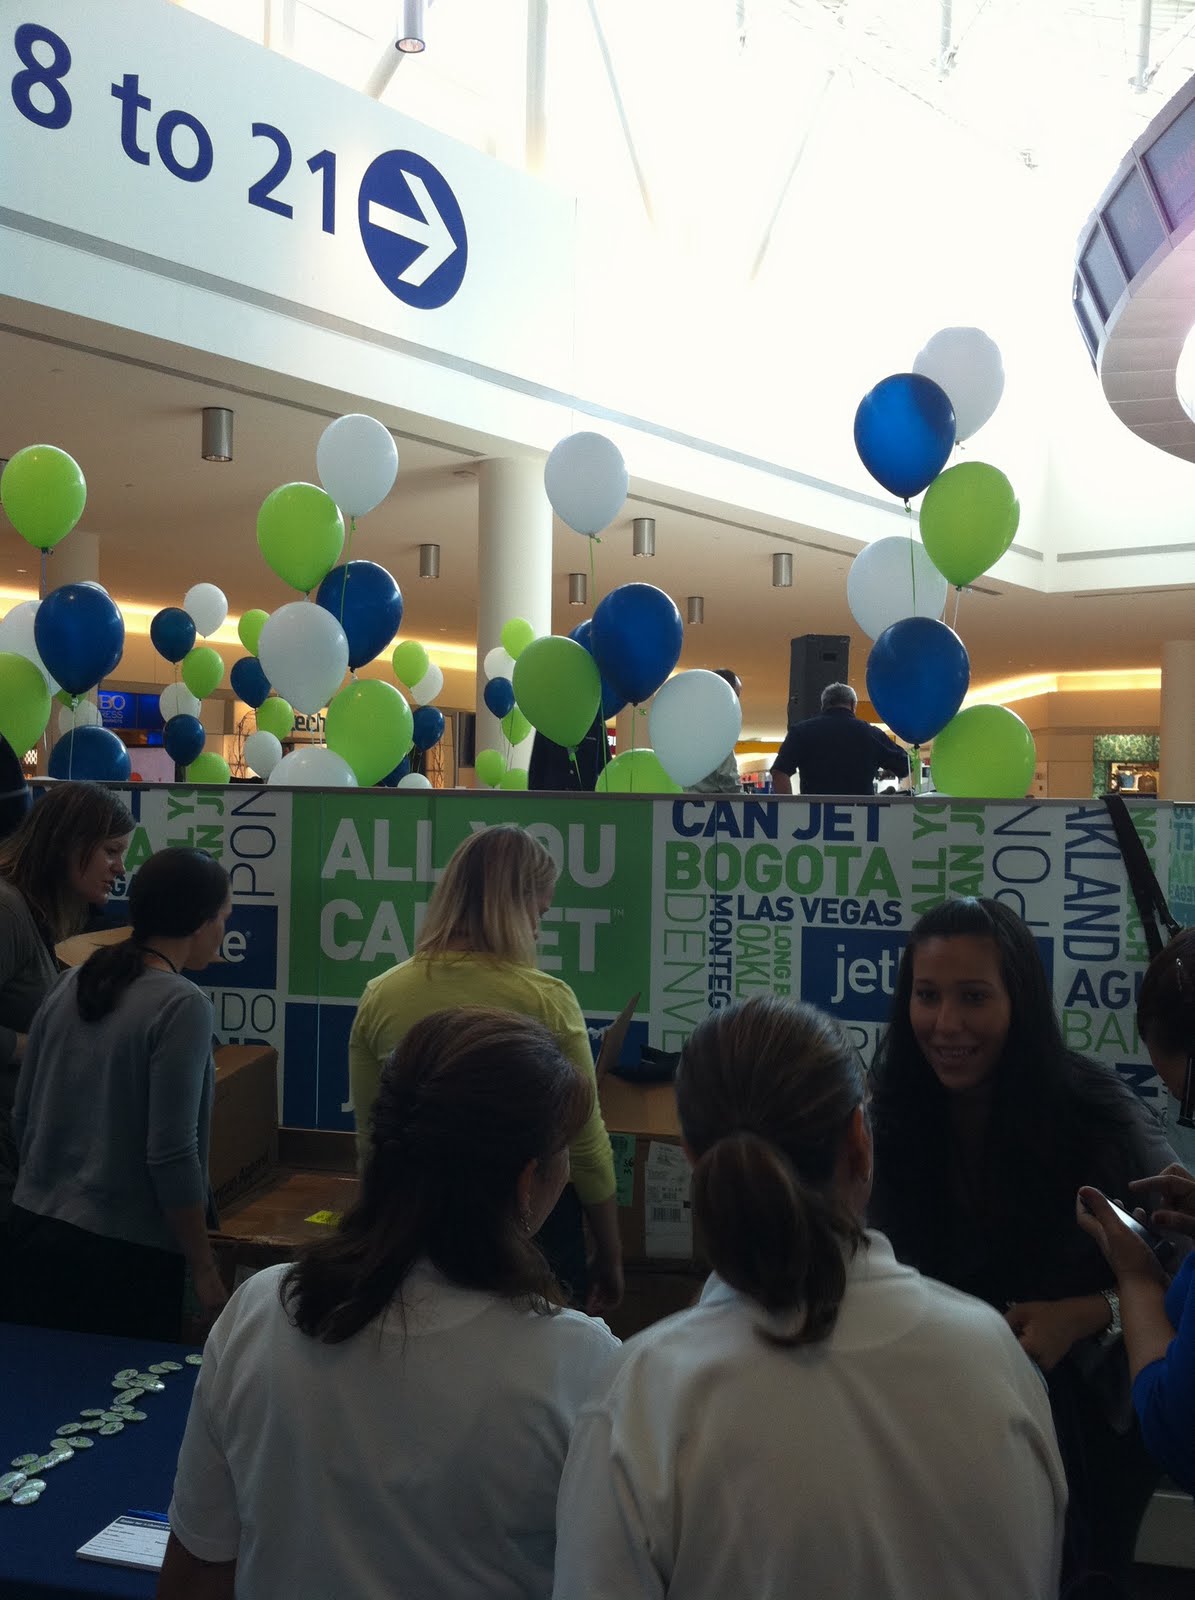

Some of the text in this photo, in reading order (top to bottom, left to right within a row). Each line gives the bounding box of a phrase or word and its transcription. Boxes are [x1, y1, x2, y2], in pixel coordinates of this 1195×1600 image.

[11, 23, 336, 236] 8 to 21
[292, 713, 326, 732] ech
[672, 800, 891, 842] CAN JET
[321, 818, 617, 888] ALL OU
[664, 841, 903, 898] BOGOTA
[737, 895, 902, 926] LAS VEGAS
[831, 944, 904, 1004] jet
